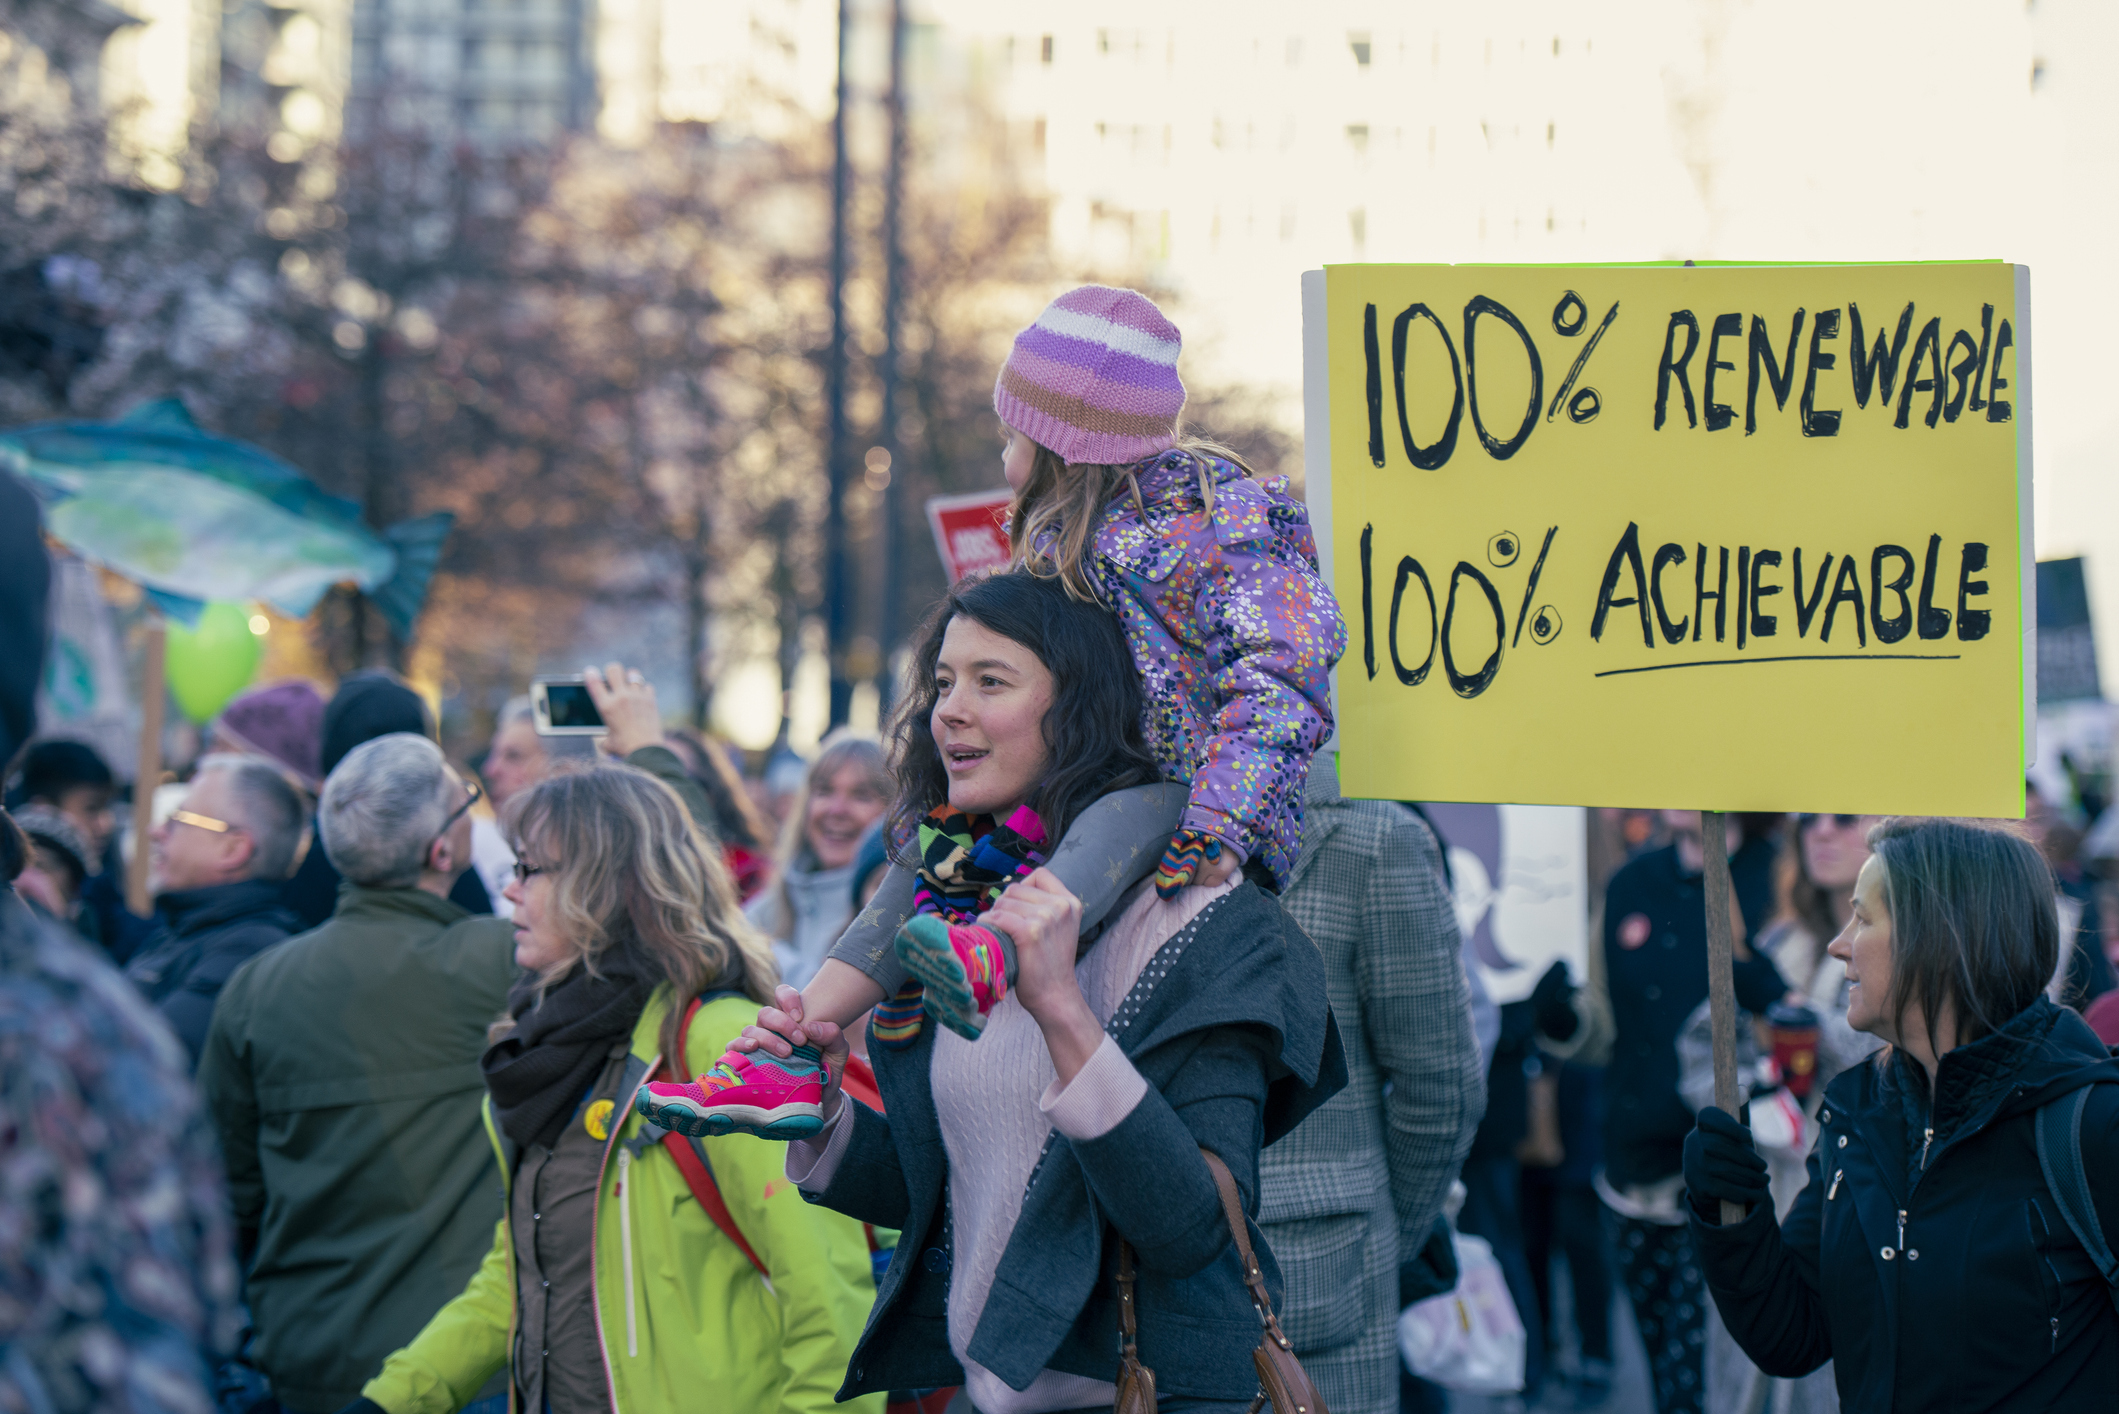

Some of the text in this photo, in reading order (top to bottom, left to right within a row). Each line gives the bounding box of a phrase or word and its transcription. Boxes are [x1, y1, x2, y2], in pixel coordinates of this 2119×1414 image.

[1363, 290, 2013, 471] 100% RENEWABLE
[1360, 521, 1991, 699] 100% ACHIEVABLE
